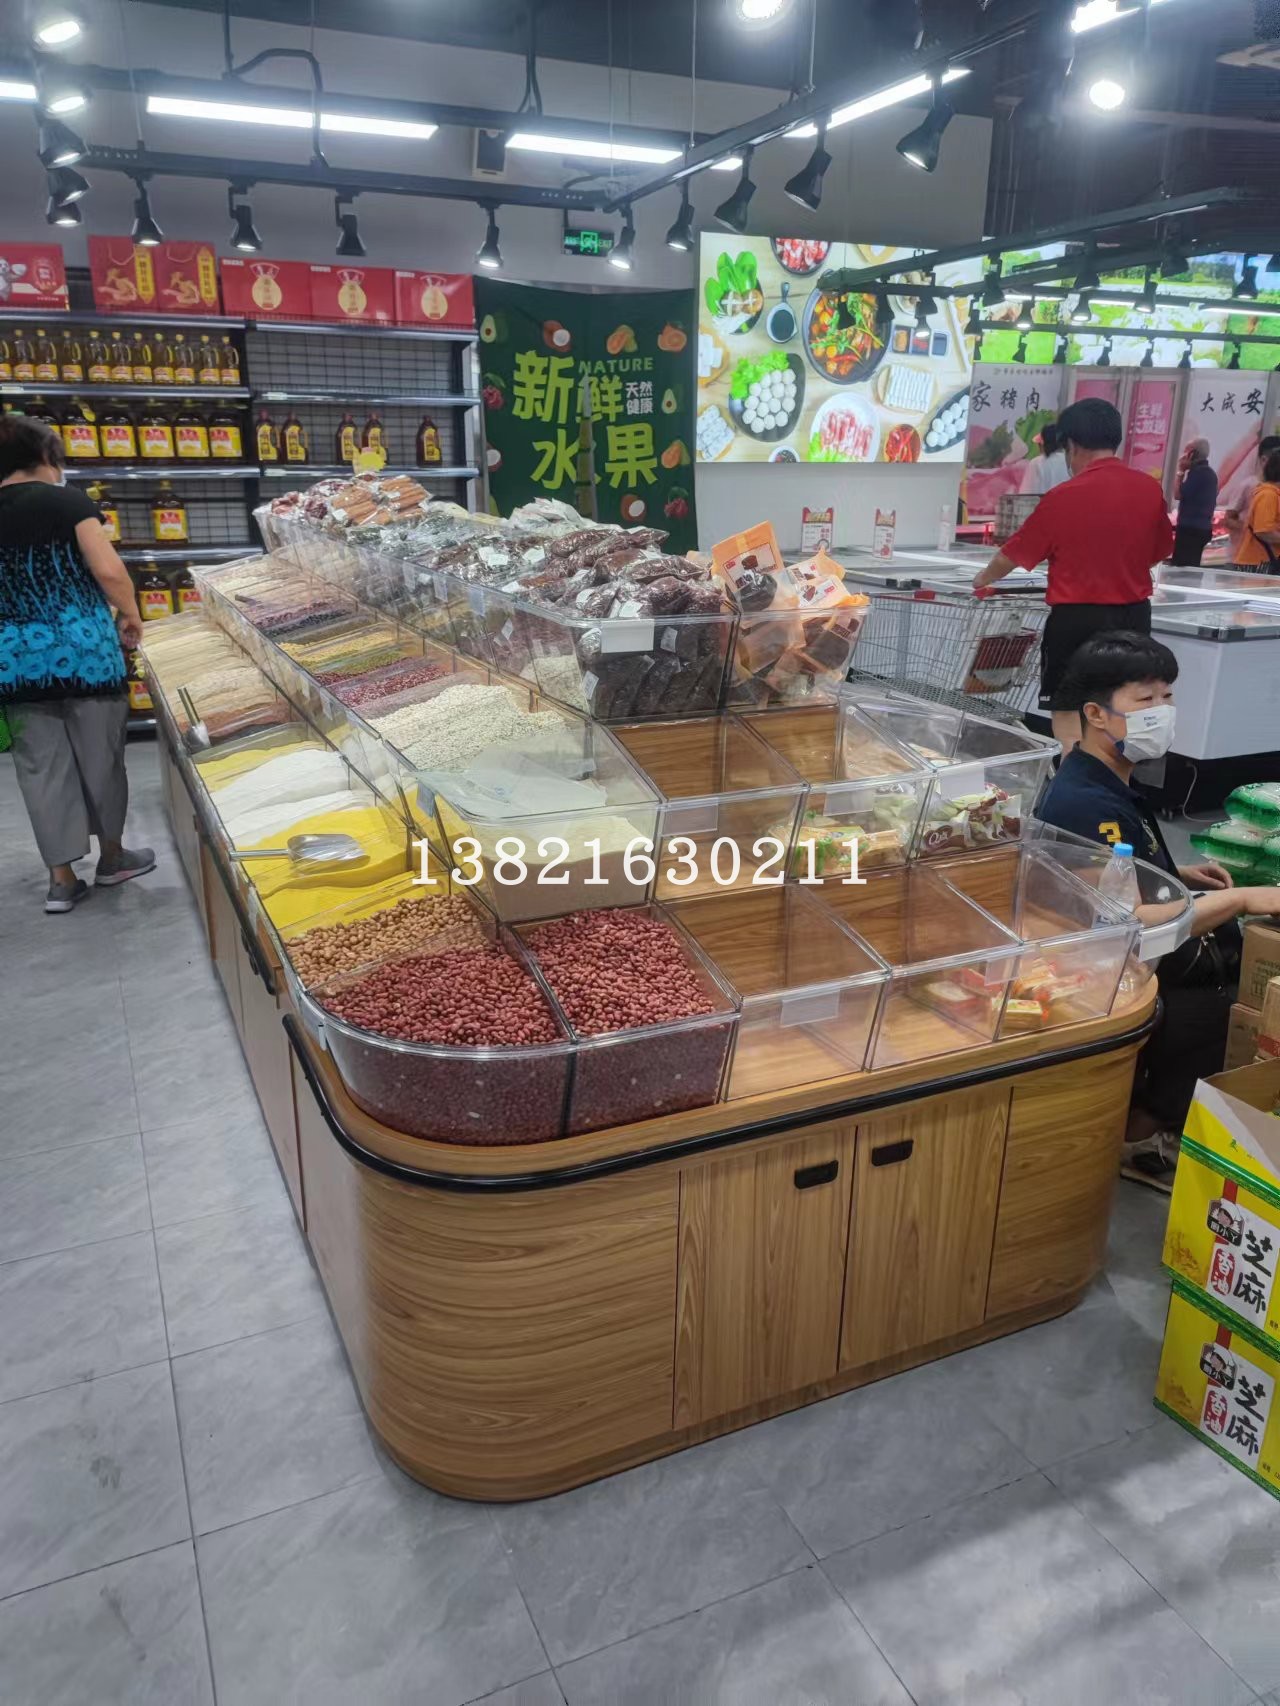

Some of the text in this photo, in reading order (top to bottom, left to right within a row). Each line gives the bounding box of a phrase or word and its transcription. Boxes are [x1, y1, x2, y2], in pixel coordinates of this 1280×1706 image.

[511, 350, 625, 424] 新鲜
[578, 357, 654, 374] NATURE
[625, 381, 653, 398] 天然
[626, 398, 654, 415] 健康
[972, 380, 1040, 412] 家猪肉
[529, 421, 659, 490] 水果
[1210, 1250, 1234, 1296] 香油
[1232, 1229, 1273, 1314] 芝麻
[1203, 1390, 1227, 1435] 香油
[1225, 1375, 1266, 1456] 芝麻
